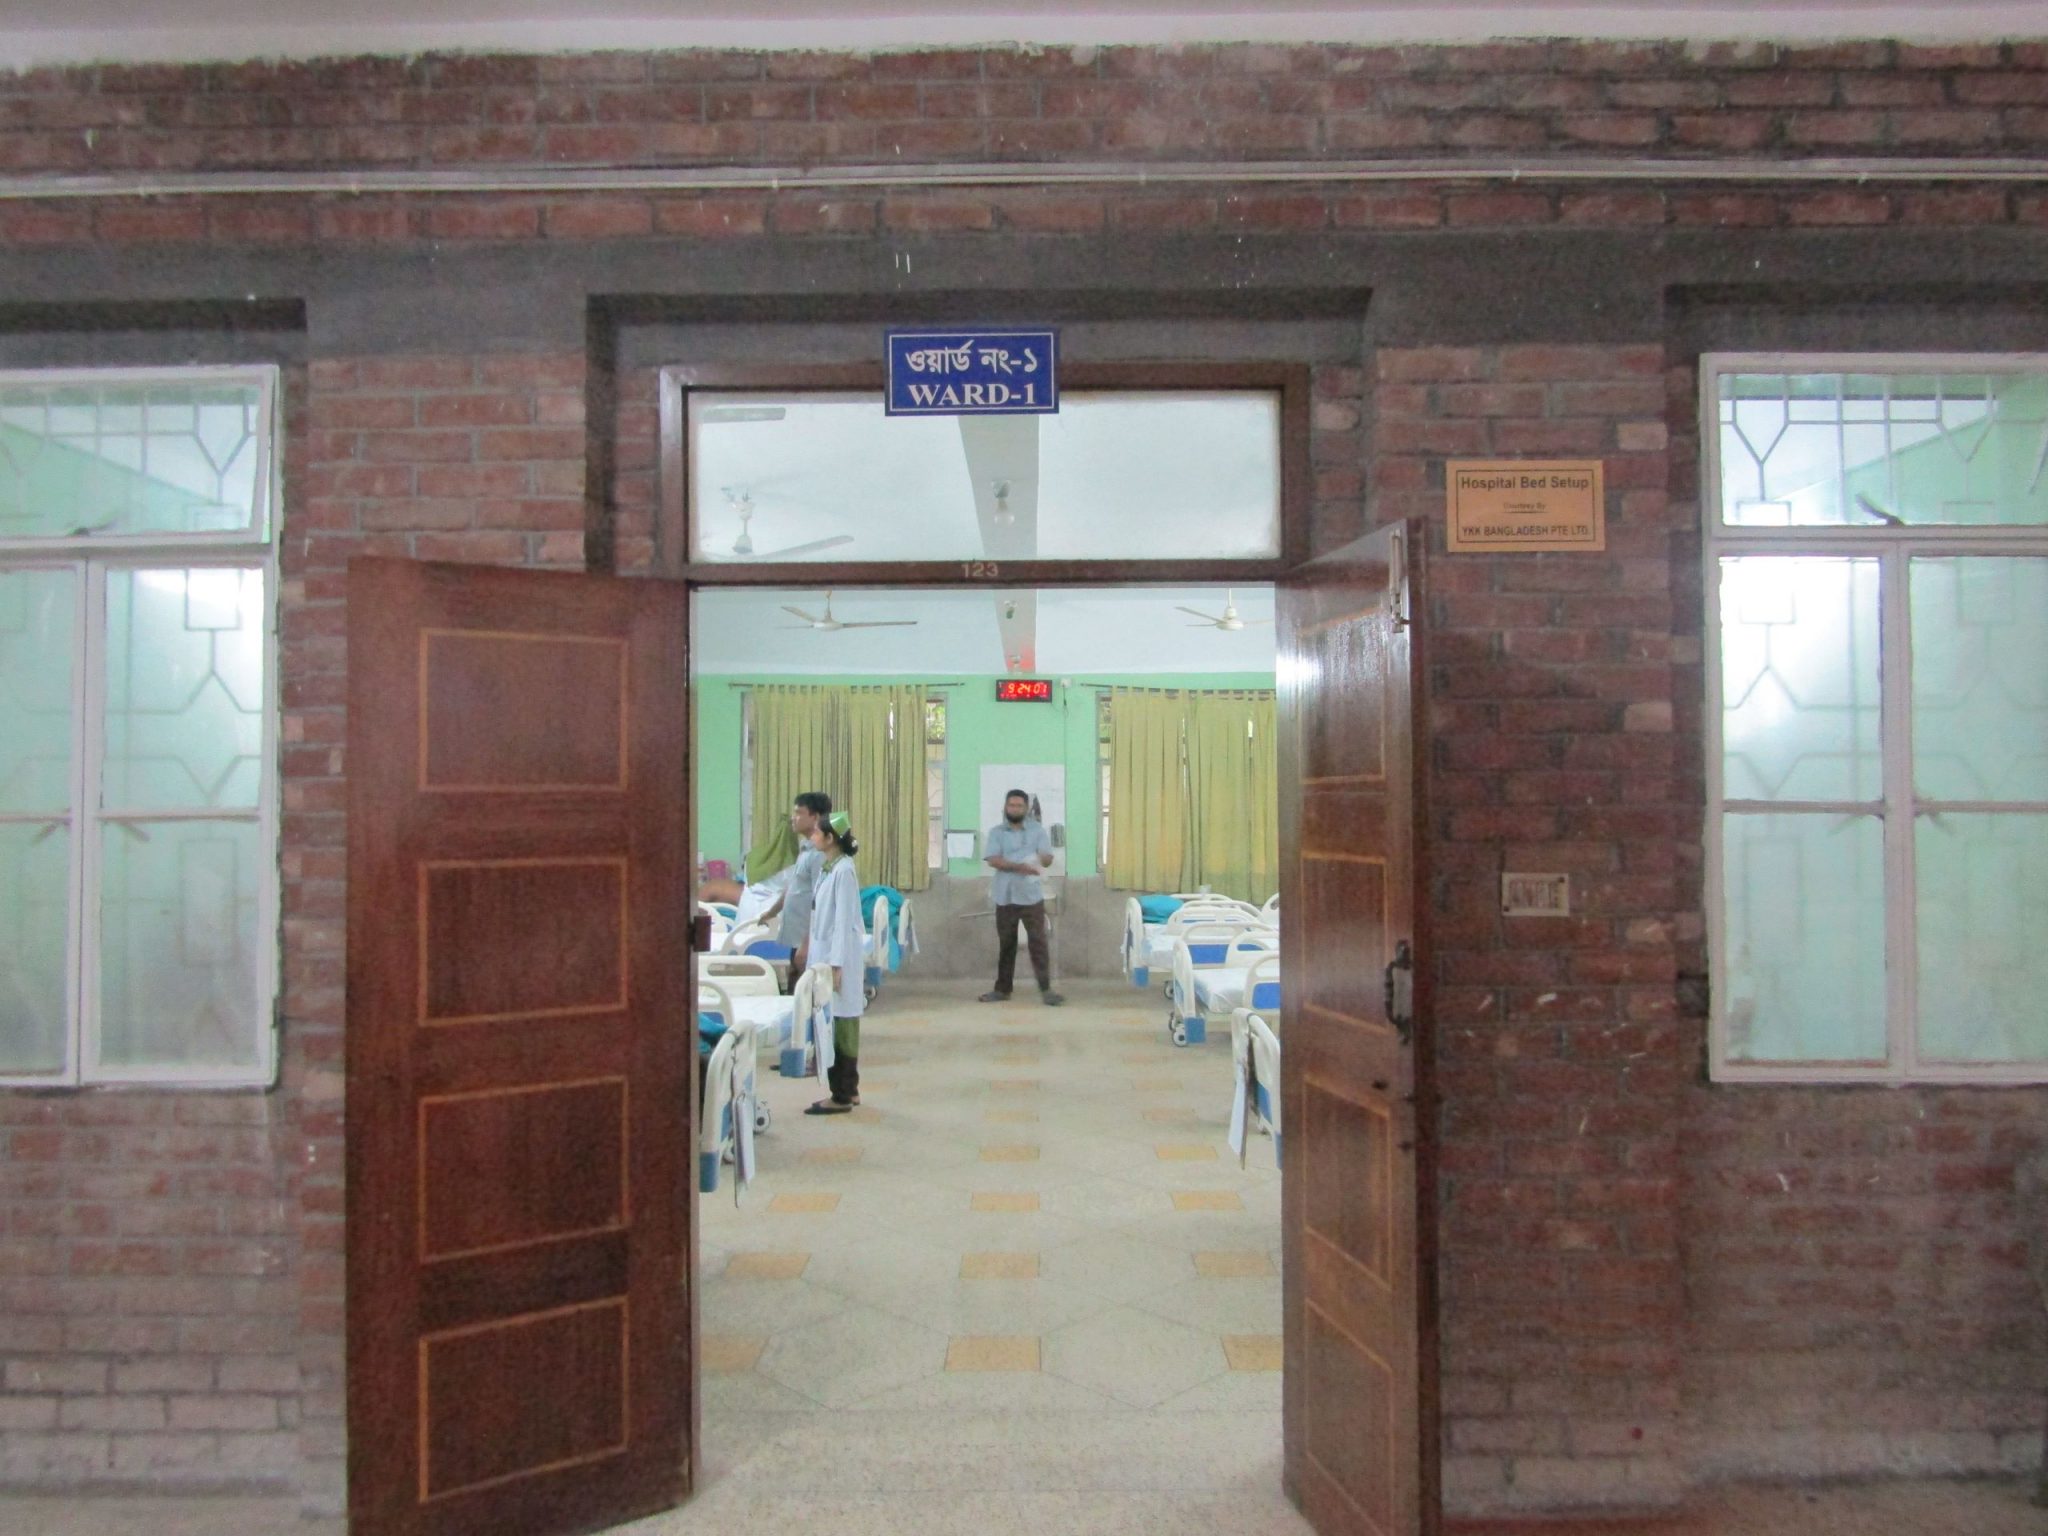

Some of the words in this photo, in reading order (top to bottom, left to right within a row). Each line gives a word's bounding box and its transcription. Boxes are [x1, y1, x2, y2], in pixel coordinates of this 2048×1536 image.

[905, 339, 975, 374] ওয়ার্ড
[907, 382, 1036, 406] WARD-1
[1461, 476, 1516, 491] Hospital
[1520, 476, 1546, 489] Bed
[1551, 476, 1589, 491] Setup
[1462, 527, 1481, 536] YKK
[1483, 526, 1549, 537] BANGLADESH
[1551, 526, 1569, 536] PTE
[961, 562, 999, 578] 123
